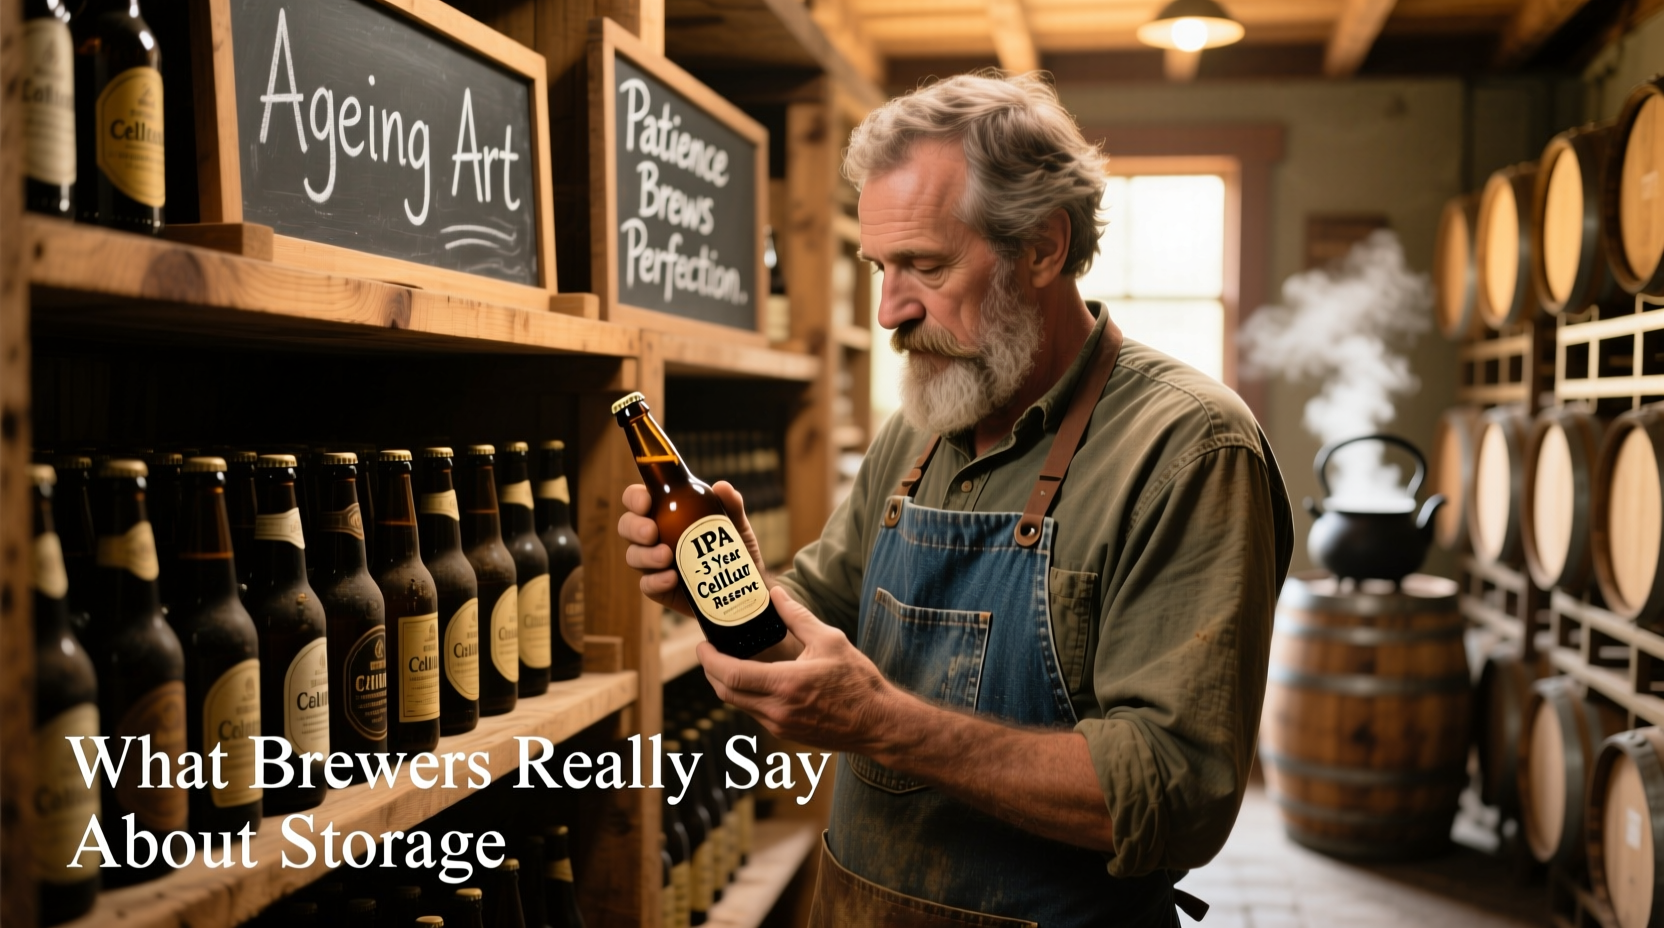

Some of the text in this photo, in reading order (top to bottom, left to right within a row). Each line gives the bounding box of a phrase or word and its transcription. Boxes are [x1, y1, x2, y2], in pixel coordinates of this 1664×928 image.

[260, 7, 520, 226] Ageing Art
[619, 78, 729, 188] Patience
[636, 160, 714, 235] Brews
[620, 217, 748, 304] Perfection.
[691, 526, 734, 559] IPA
[711, 549, 741, 568] Year
